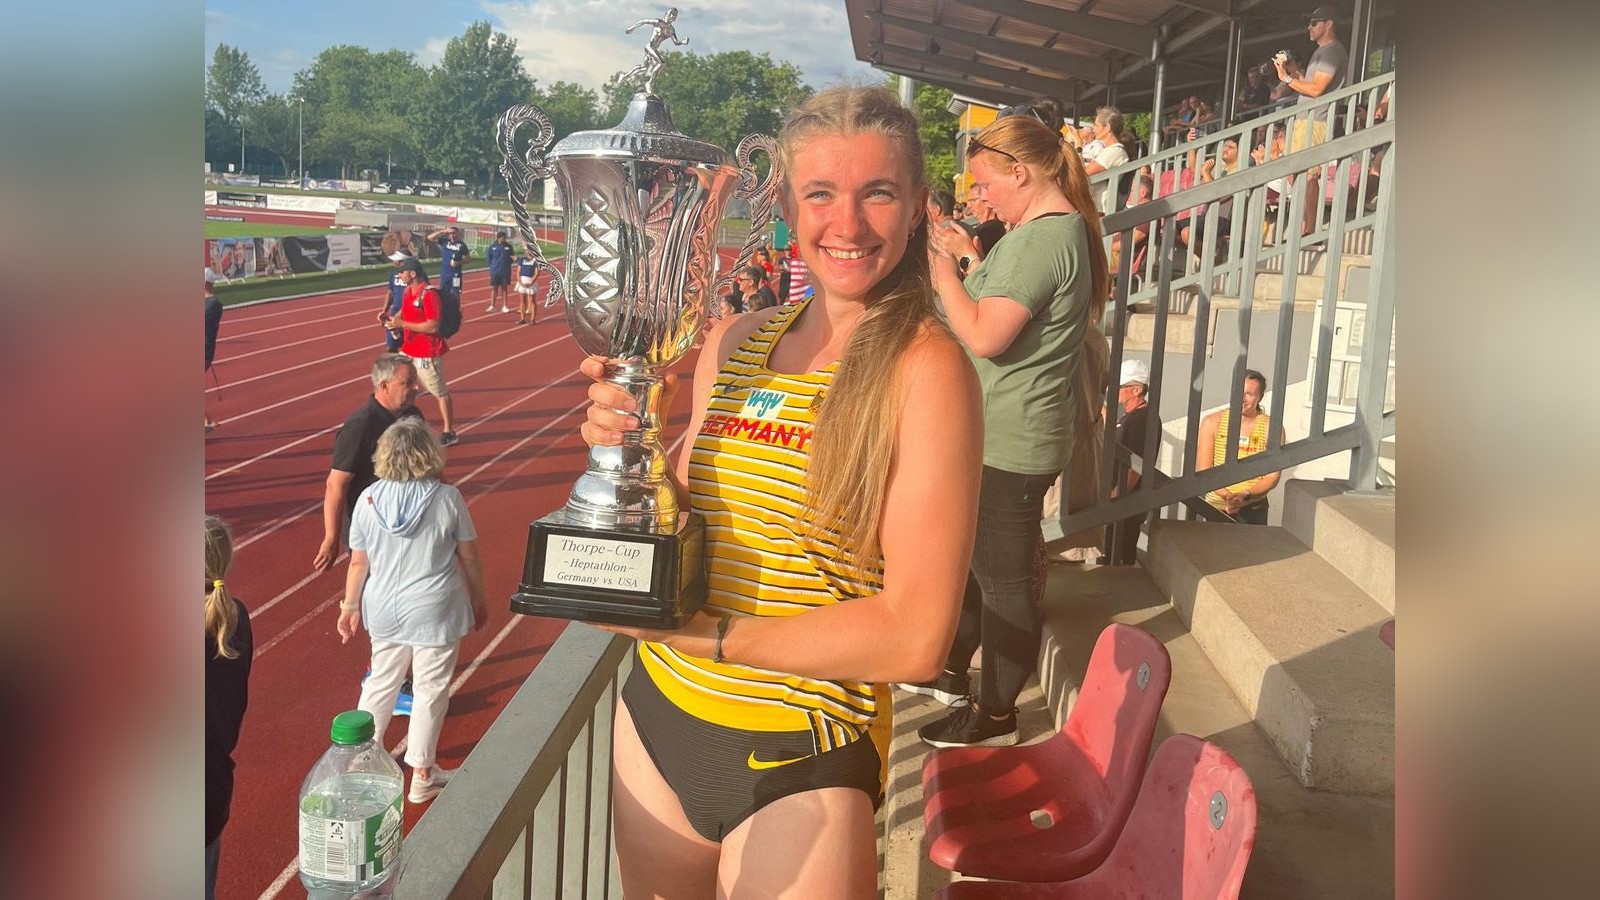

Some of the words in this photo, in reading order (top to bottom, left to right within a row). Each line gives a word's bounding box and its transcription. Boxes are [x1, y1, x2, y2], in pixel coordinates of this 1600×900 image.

[700, 415, 812, 449] GERMANY
[557, 571, 600, 584] Germany
[618, 577, 638, 588] USA
